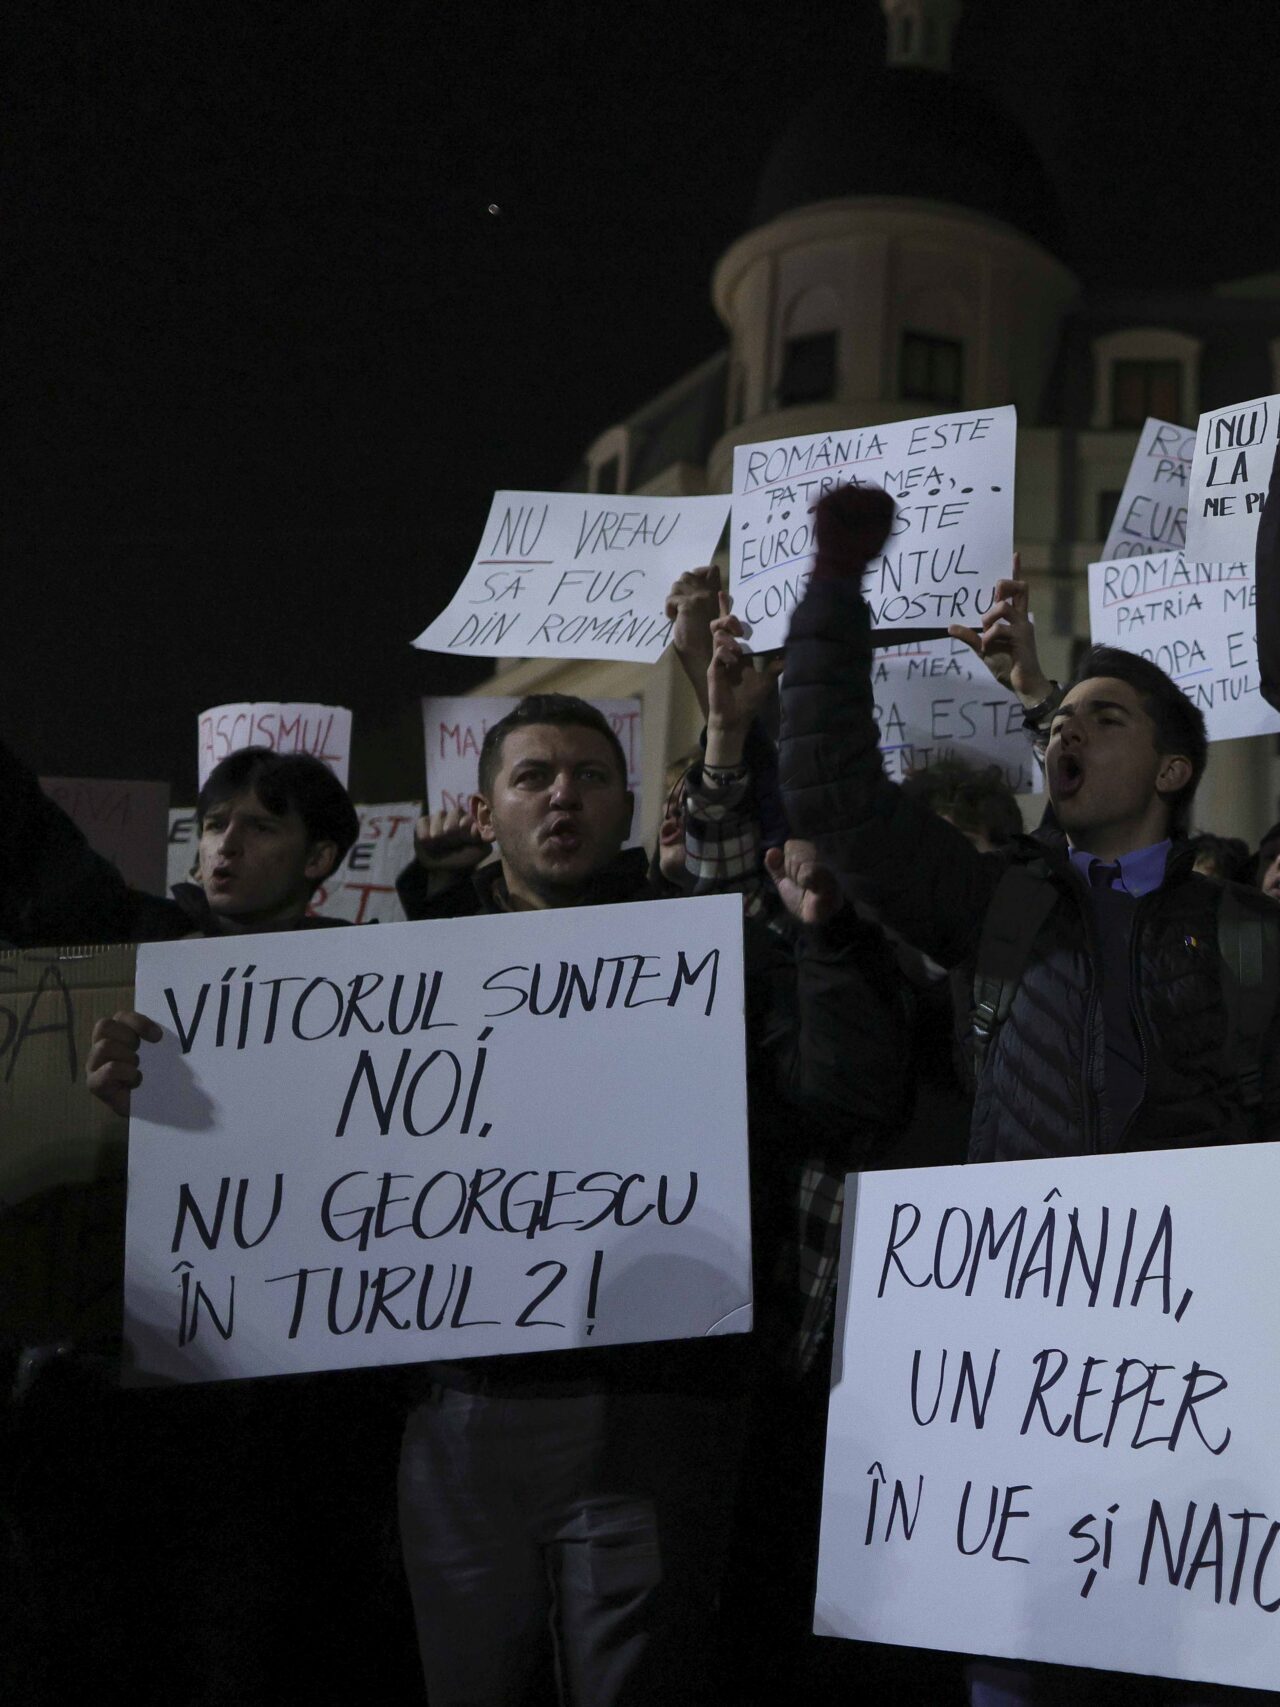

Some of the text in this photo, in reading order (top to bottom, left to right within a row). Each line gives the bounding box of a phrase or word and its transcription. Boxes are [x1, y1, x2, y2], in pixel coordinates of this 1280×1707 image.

[907, 418, 994, 457] ESTE
[1215, 411, 1258, 449] NU
[1206, 450, 1249, 488] LA
[491, 504, 681, 560] NU VREAU
[1203, 496, 1237, 517] NE
[740, 502, 970, 579] EURO STE
[548, 569, 646, 605] FUG
[931, 697, 1025, 741] ESTE
[483, 949, 720, 1021] SUNTEM
[170, 1168, 698, 1253] NU GEORGESCU
[877, 1186, 1194, 1323] ROMÂNIA,
[172, 1260, 236, 1348] ÎN
[265, 1262, 501, 1341] TURUL
[911, 1347, 1232, 1456] UN REPER
[864, 1460, 924, 1546] ÎN
[956, 1480, 1034, 1565] UE
